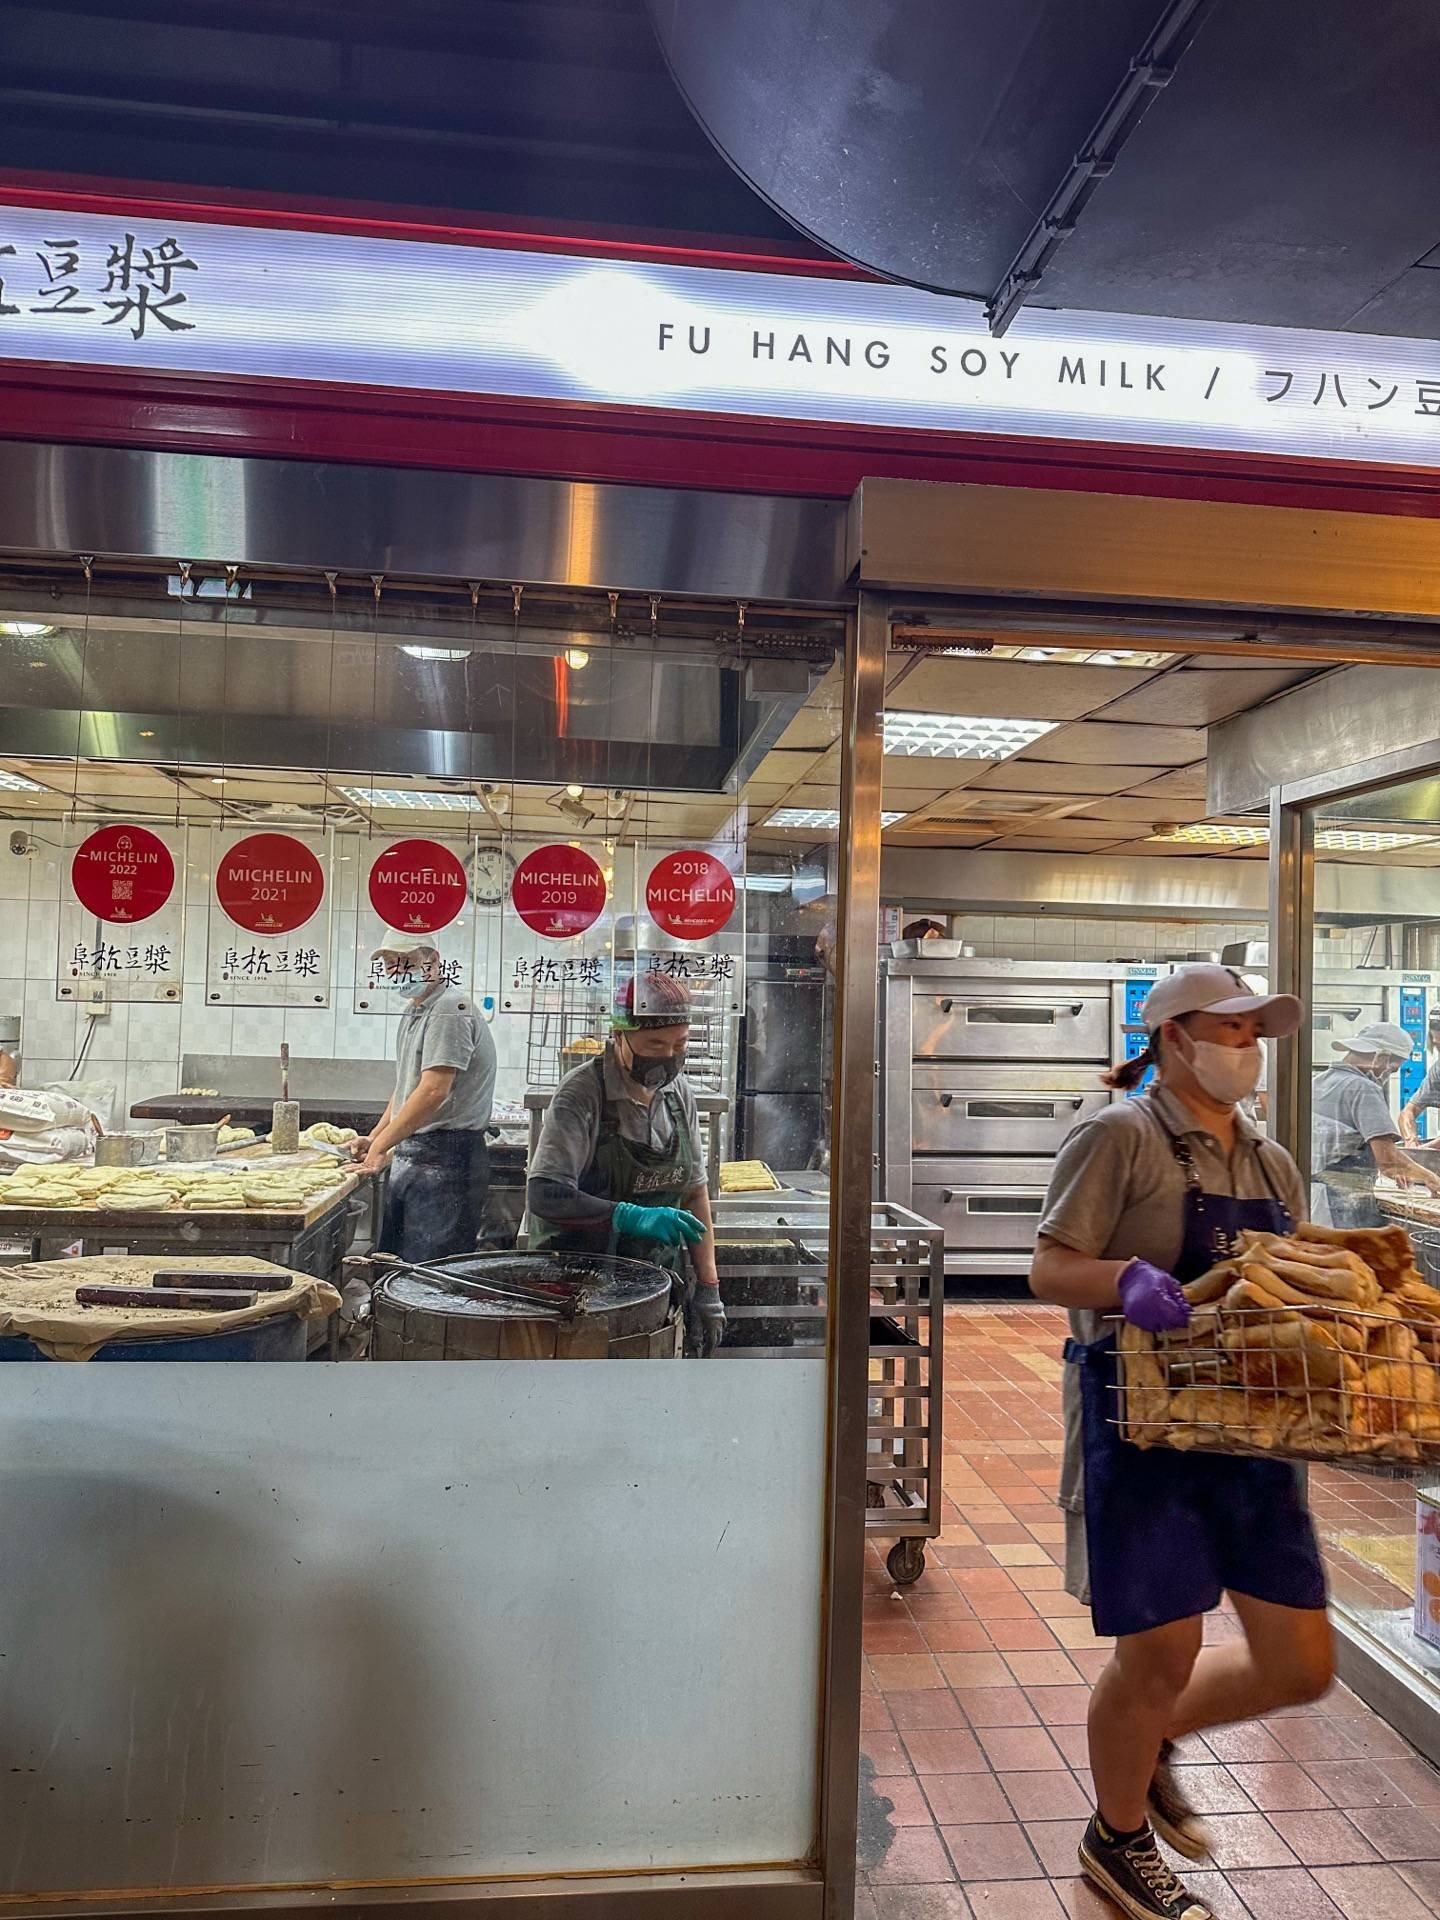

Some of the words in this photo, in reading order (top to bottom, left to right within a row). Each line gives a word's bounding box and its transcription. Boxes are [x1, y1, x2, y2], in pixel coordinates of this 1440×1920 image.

[659, 323, 711, 354] FU
[752, 330, 890, 369] HANG
[930, 346, 1020, 379] SOY
[1058, 356, 1166, 391] MILK
[1204, 366, 1221, 400] /
[1265, 370, 1440, 415] フハン豆
[90, 850, 158, 864] MICHELIN
[109, 864, 137, 875] 2022
[228, 868, 312, 884] MICHELIN
[673, 862, 709, 875] 2018
[377, 871, 459, 886] MICHELIN
[520, 872, 599, 887] MICHELIN
[251, 887, 287, 901] 2021
[400, 891, 435, 904] 2020
[541, 891, 577, 904] 2019
[648, 888, 734, 903] MICHELIN
[70, 942, 171, 974] 阜杭豆漿
[221, 946, 320, 977] 阜杭豆漿
[367, 956, 462, 988] 阜杭豆漿
[512, 956, 603, 986] 阜杭豆漿
[646, 952, 734, 981] 阜杭豆漿
